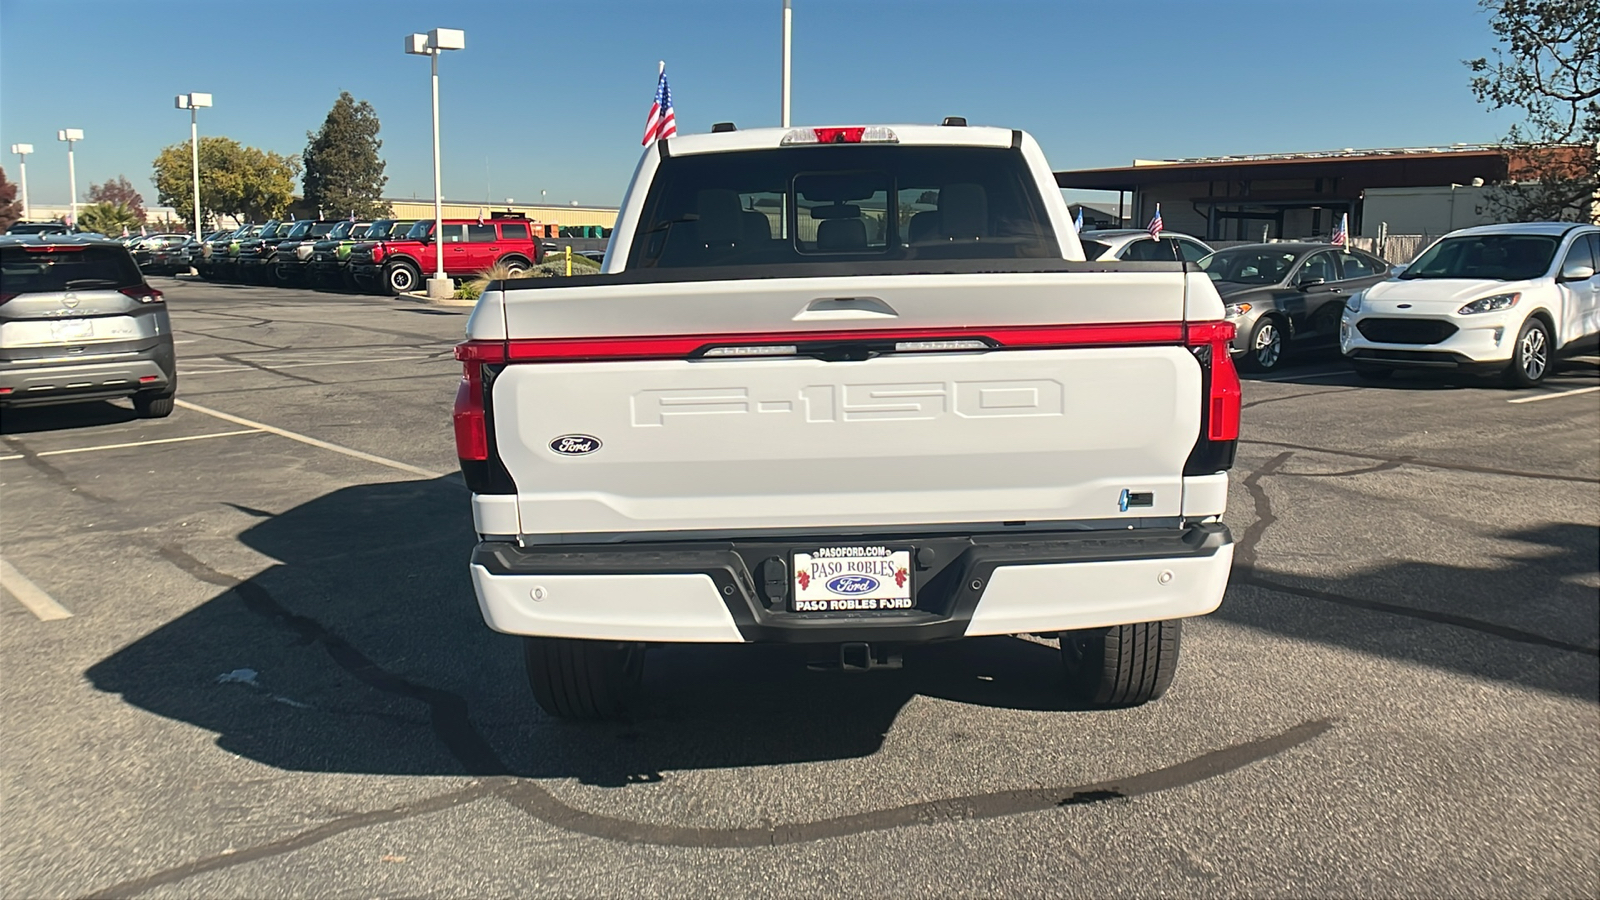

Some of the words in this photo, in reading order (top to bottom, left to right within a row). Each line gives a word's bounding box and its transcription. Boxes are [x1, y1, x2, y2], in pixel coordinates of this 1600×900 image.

[630, 378, 1065, 427] F-150
[558, 437, 592, 452] Ford
[819, 546, 885, 558] PASOFORD.COM
[811, 561, 842, 580] PASO
[847, 560, 895, 578] ROBLES
[836, 577, 870, 592] Ford
[796, 600, 828, 611] PASO
[830, 599, 877, 610] ROBLES
[880, 598, 912, 609] FORD
